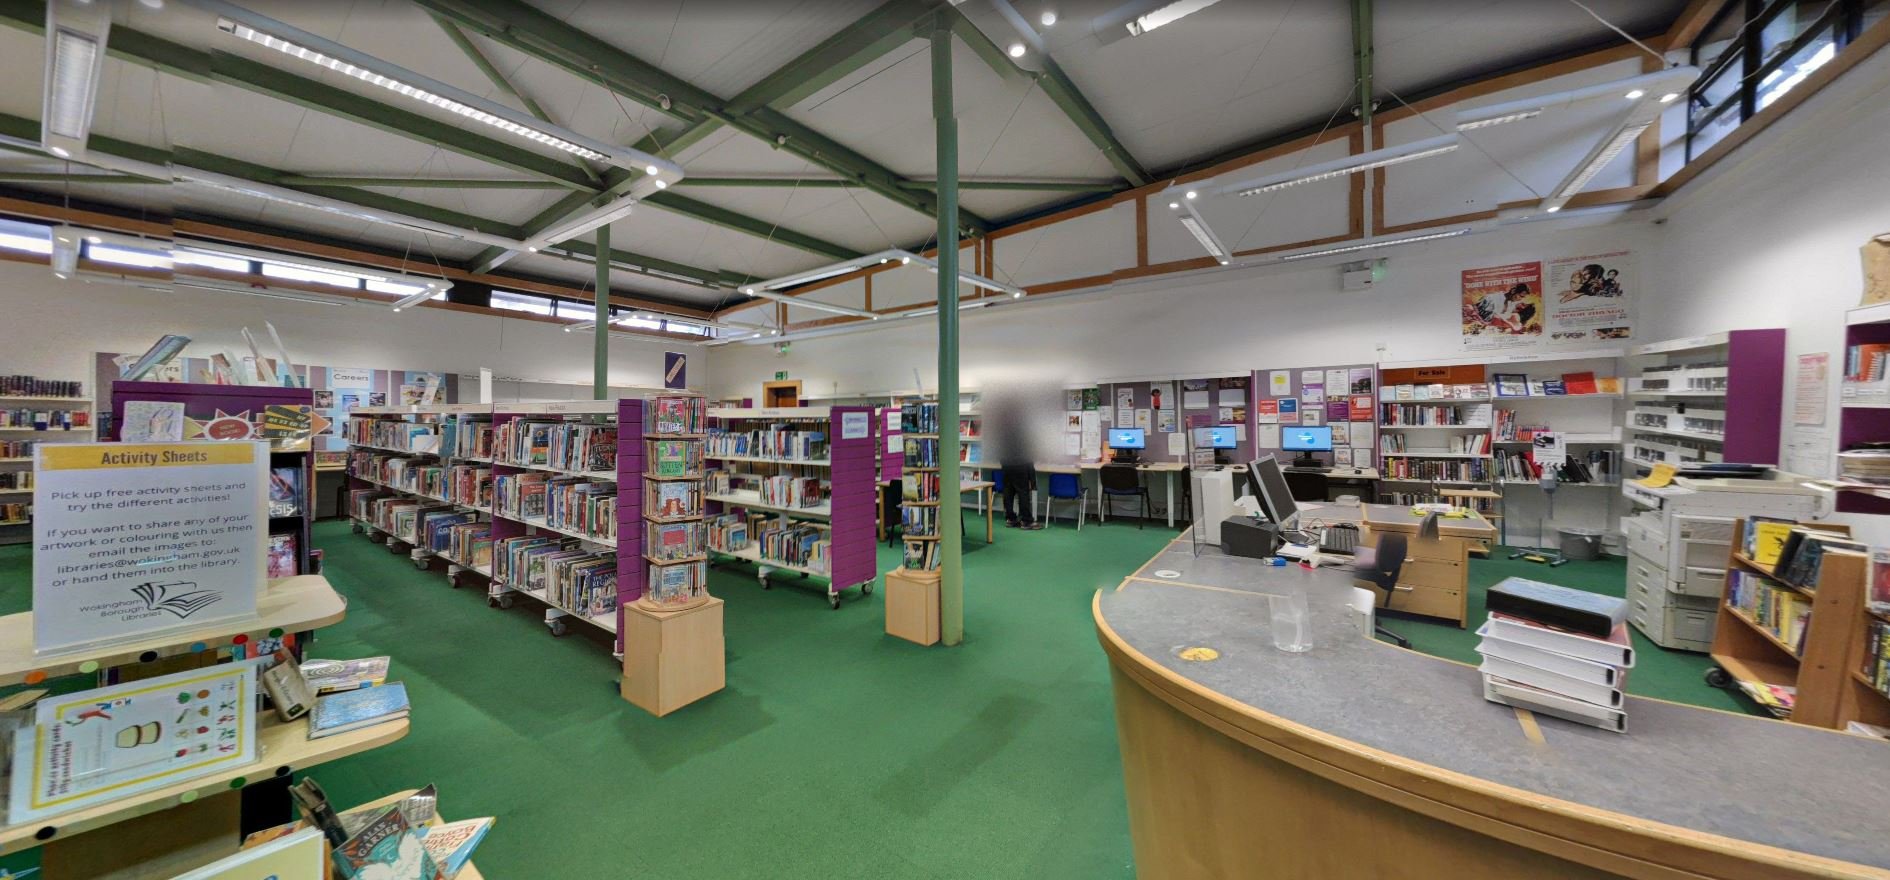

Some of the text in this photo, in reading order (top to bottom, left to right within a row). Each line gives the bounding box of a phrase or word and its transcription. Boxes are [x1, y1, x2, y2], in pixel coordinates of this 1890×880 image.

[333, 372, 370, 383] Careers
[101, 450, 208, 466] Activity Sheets
[51, 482, 246, 501] Pick up free activity sheets and
[68, 493, 231, 513] try the different activities!
[47, 514, 249, 539] If you want to share any of your
[39, 523, 253, 551] artwork or colouring with us then
[88, 538, 217, 559] email the images to:
[57, 546, 240, 574] libraries@wokingham.gov.uk
[52, 557, 240, 588] or hand them into the library.
[79, 599, 143, 612] Wokingham
[100, 605, 145, 618] Borough
[121, 610, 162, 622] Libraries
[358, 823, 400, 857] GARNER
[363, 821, 387, 841] ALAN
